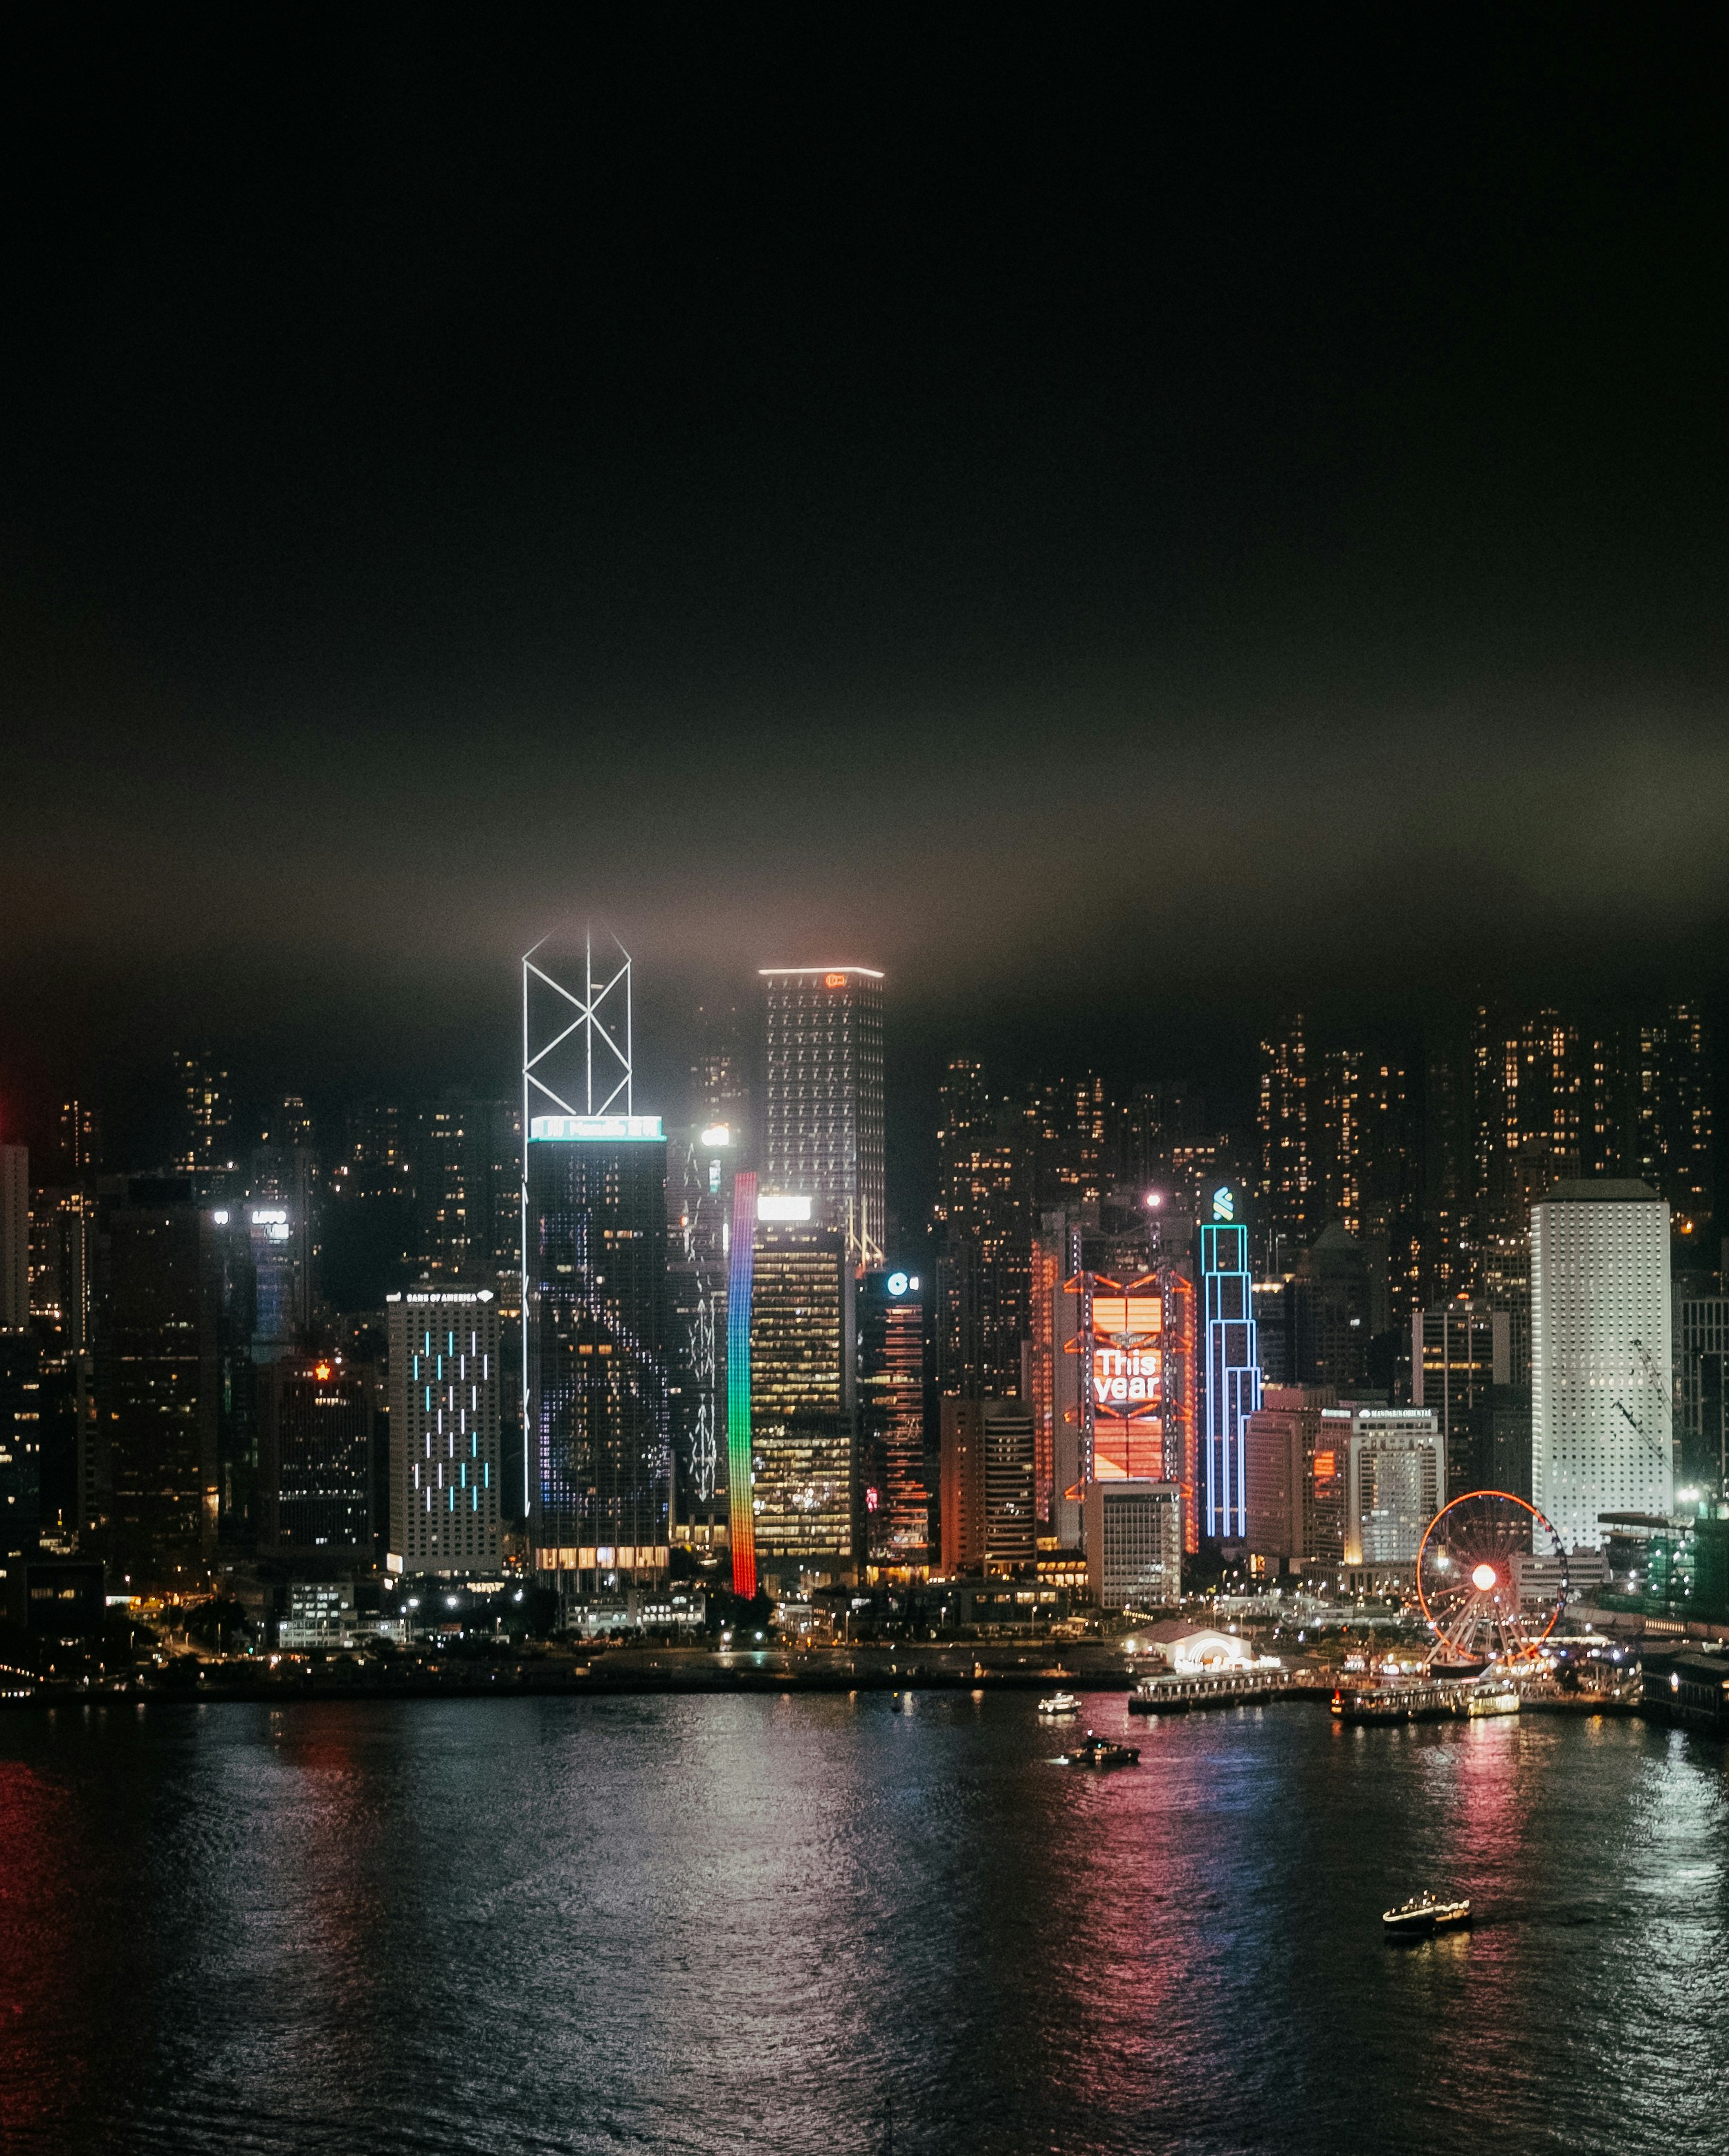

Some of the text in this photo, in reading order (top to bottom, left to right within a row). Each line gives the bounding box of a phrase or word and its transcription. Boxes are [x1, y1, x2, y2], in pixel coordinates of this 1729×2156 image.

[406, 1293, 429, 1303] BANK
[430, 1293, 441, 1303] OF
[441, 1293, 477, 1303] AMERICA
[1096, 1349, 1157, 1376] This
[1093, 1376, 1160, 1403] year
